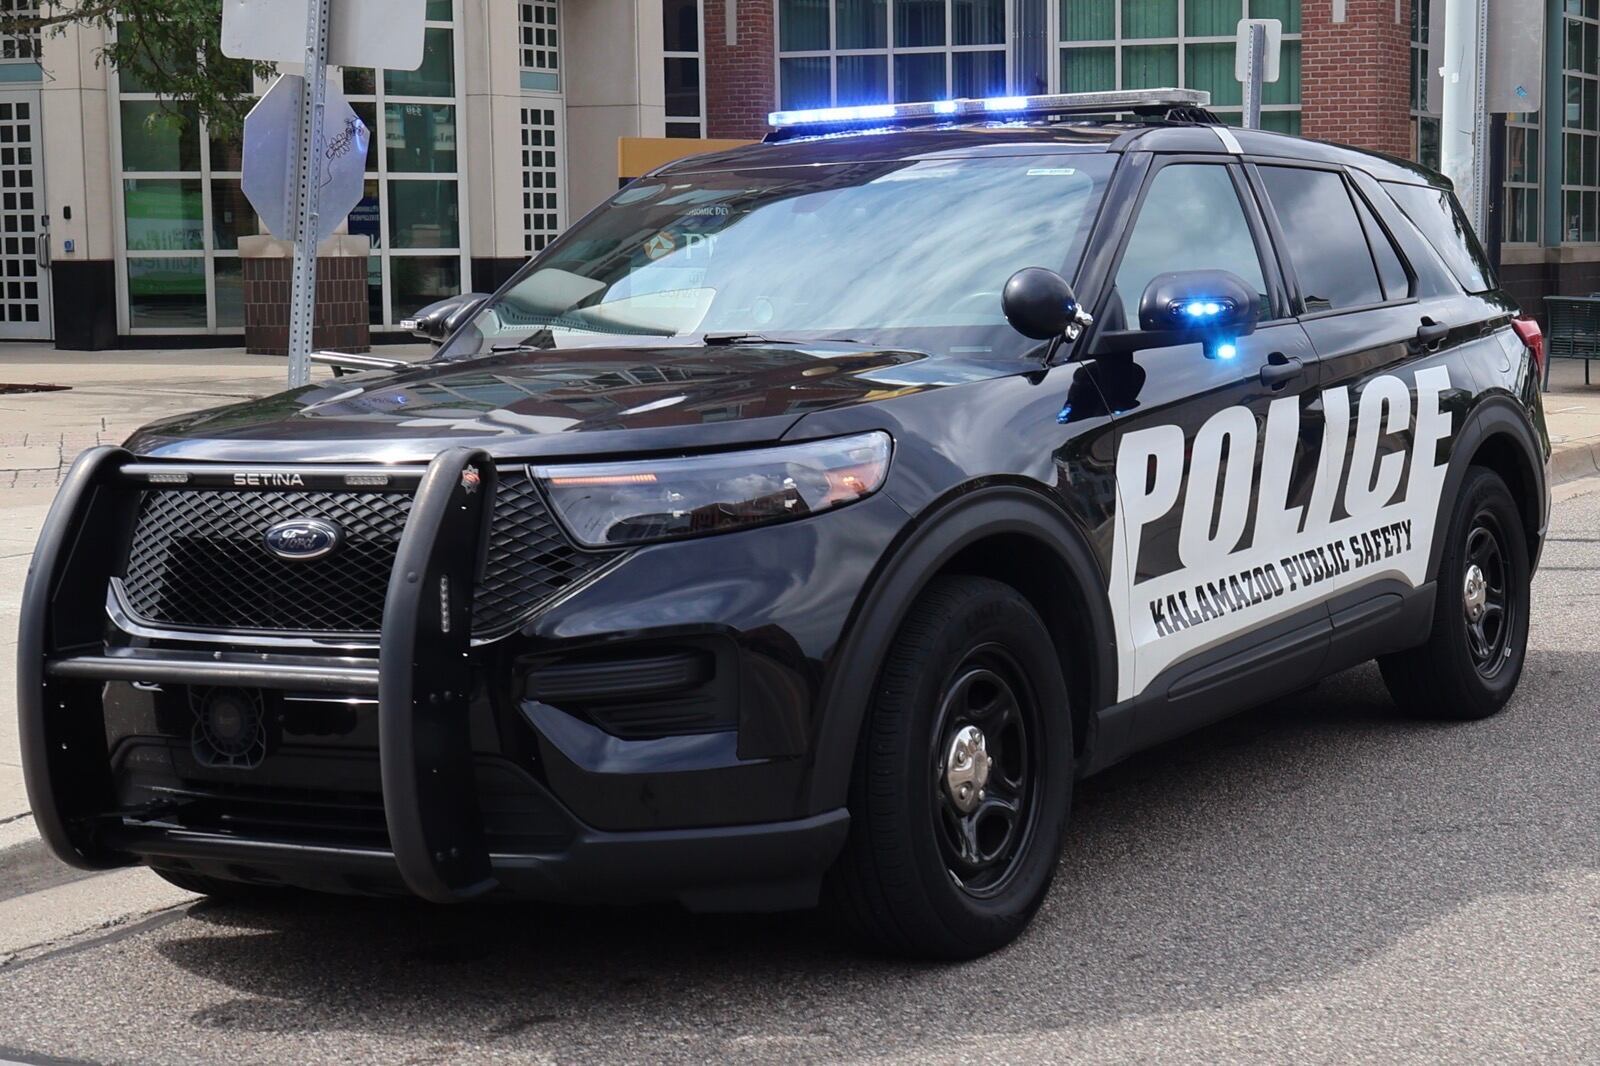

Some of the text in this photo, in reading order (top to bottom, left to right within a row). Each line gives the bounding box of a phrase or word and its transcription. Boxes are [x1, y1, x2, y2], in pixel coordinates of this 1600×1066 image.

[233, 473, 304, 486] SETINA
[1110, 365, 1452, 588] POLICE
[277, 528, 317, 549] Ford
[1149, 519, 1412, 637] KALAMAZOO PUBLIC SAFETY
